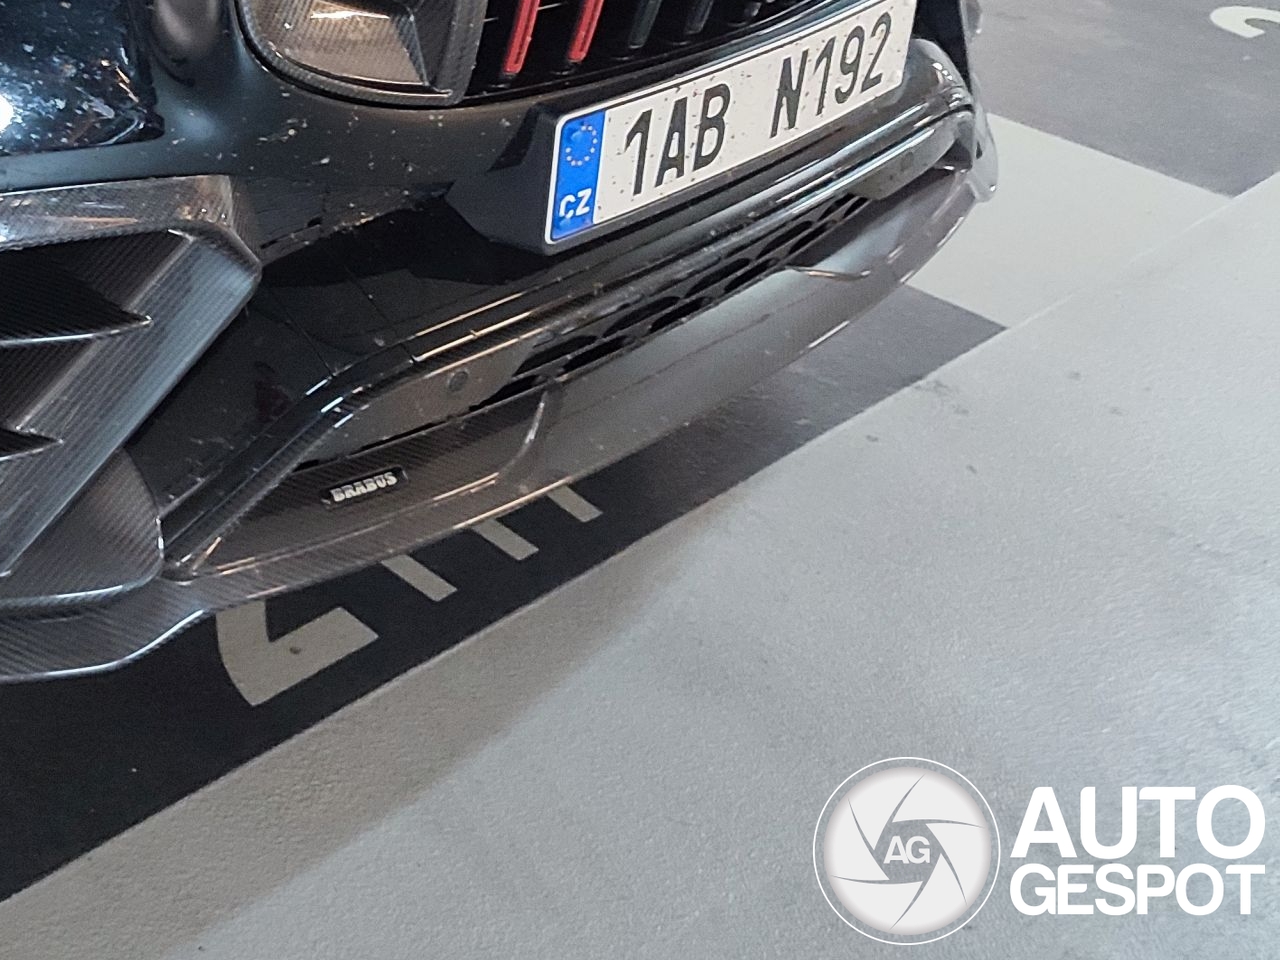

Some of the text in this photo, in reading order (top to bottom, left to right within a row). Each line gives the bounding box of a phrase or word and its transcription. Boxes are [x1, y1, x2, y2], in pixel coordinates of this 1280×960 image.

[624, 11, 892, 196] 1AB N192
[559, 188, 592, 219] CZ
[330, 471, 398, 502] BRABUS
